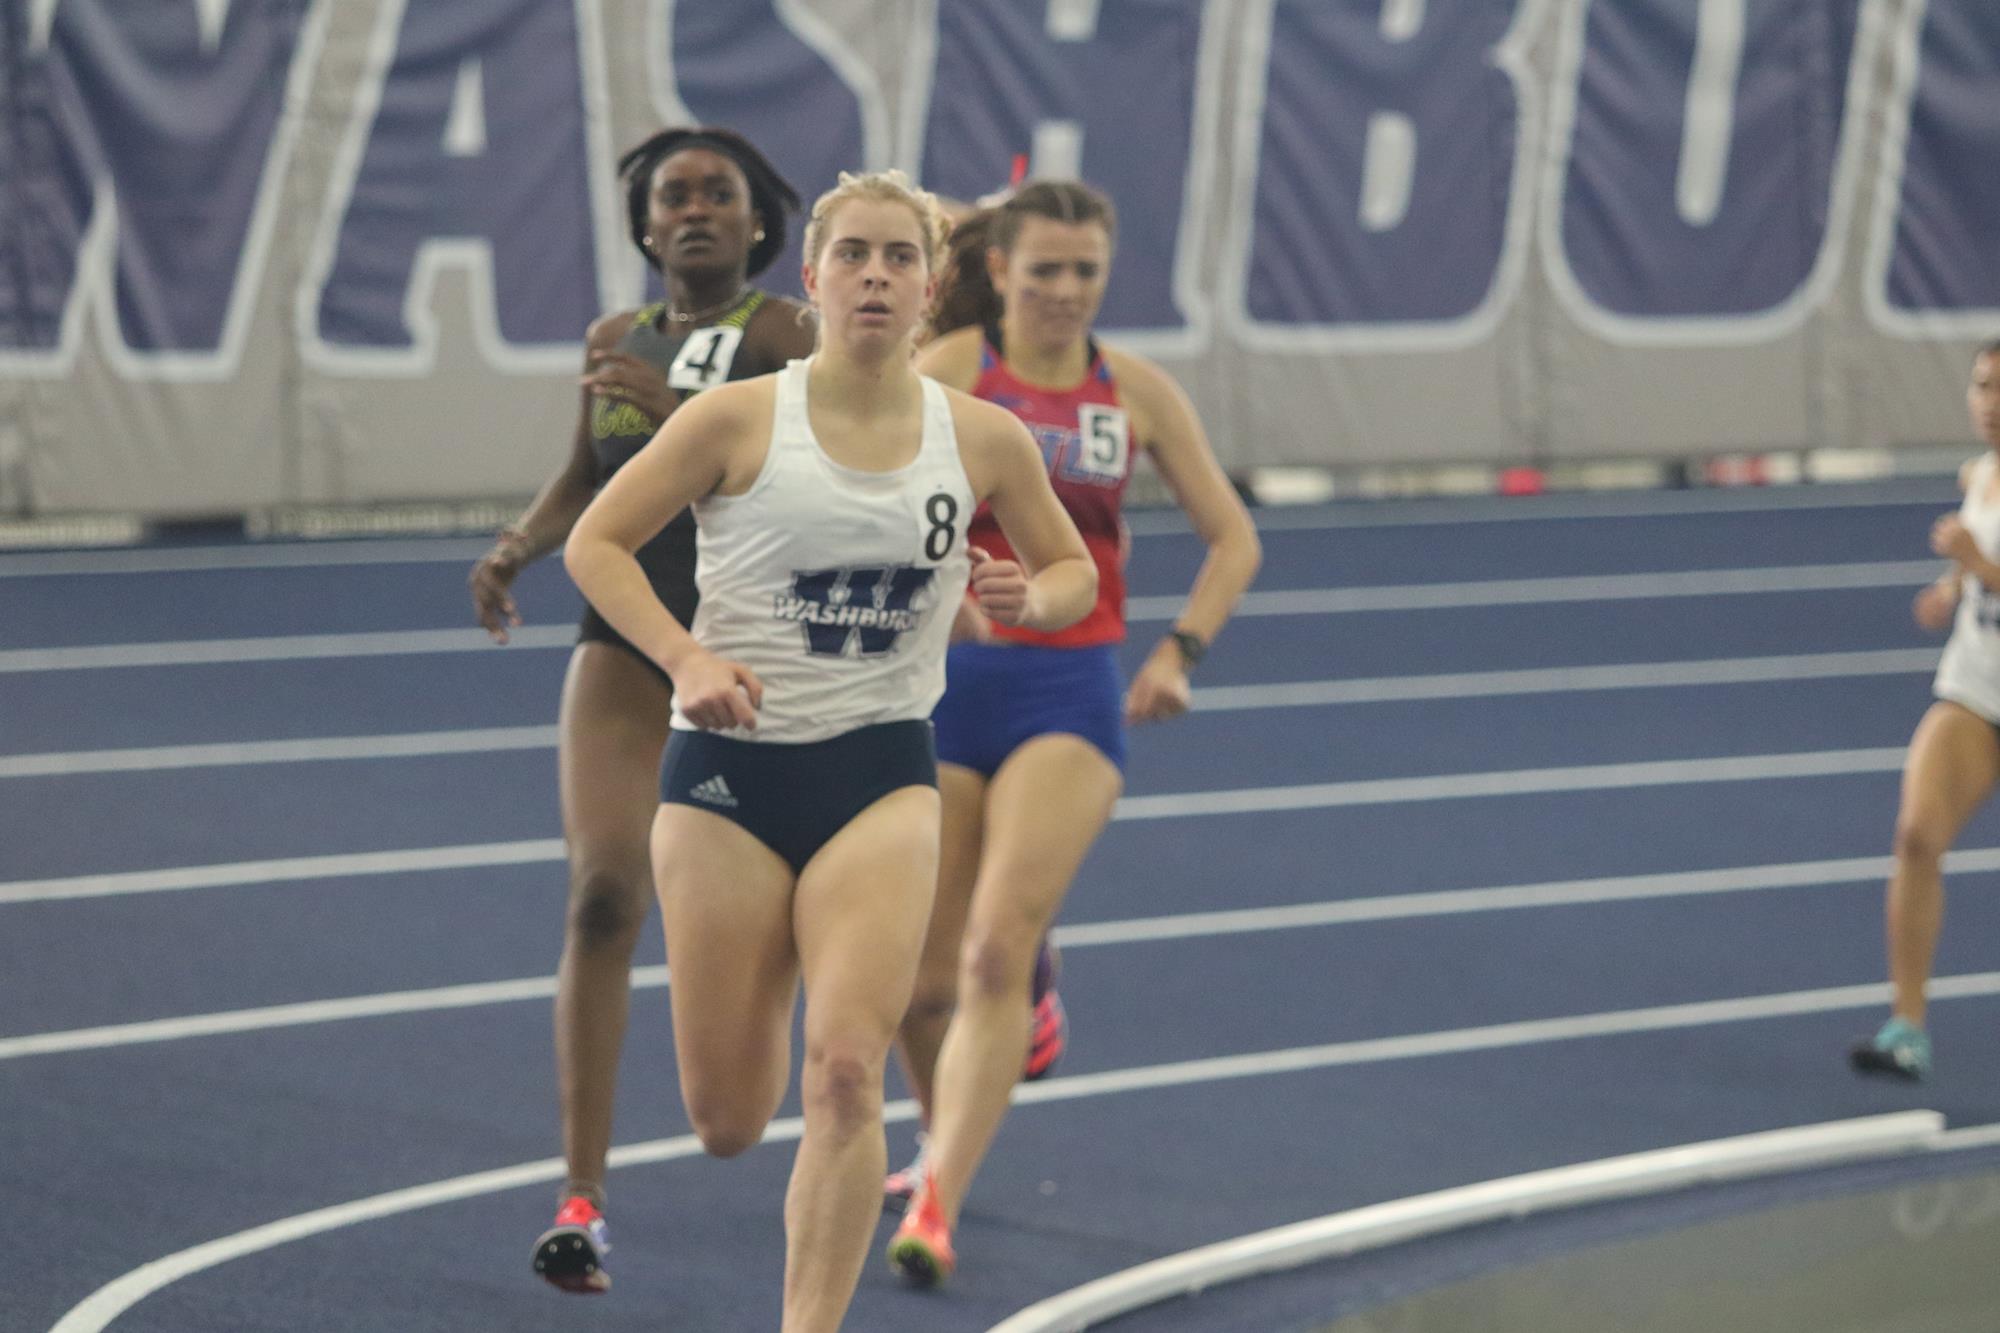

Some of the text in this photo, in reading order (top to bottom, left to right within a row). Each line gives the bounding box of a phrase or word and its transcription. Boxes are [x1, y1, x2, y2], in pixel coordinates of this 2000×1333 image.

[684, 332, 724, 382] 4
[1092, 414, 1117, 465] 5
[925, 493, 958, 561] 8
